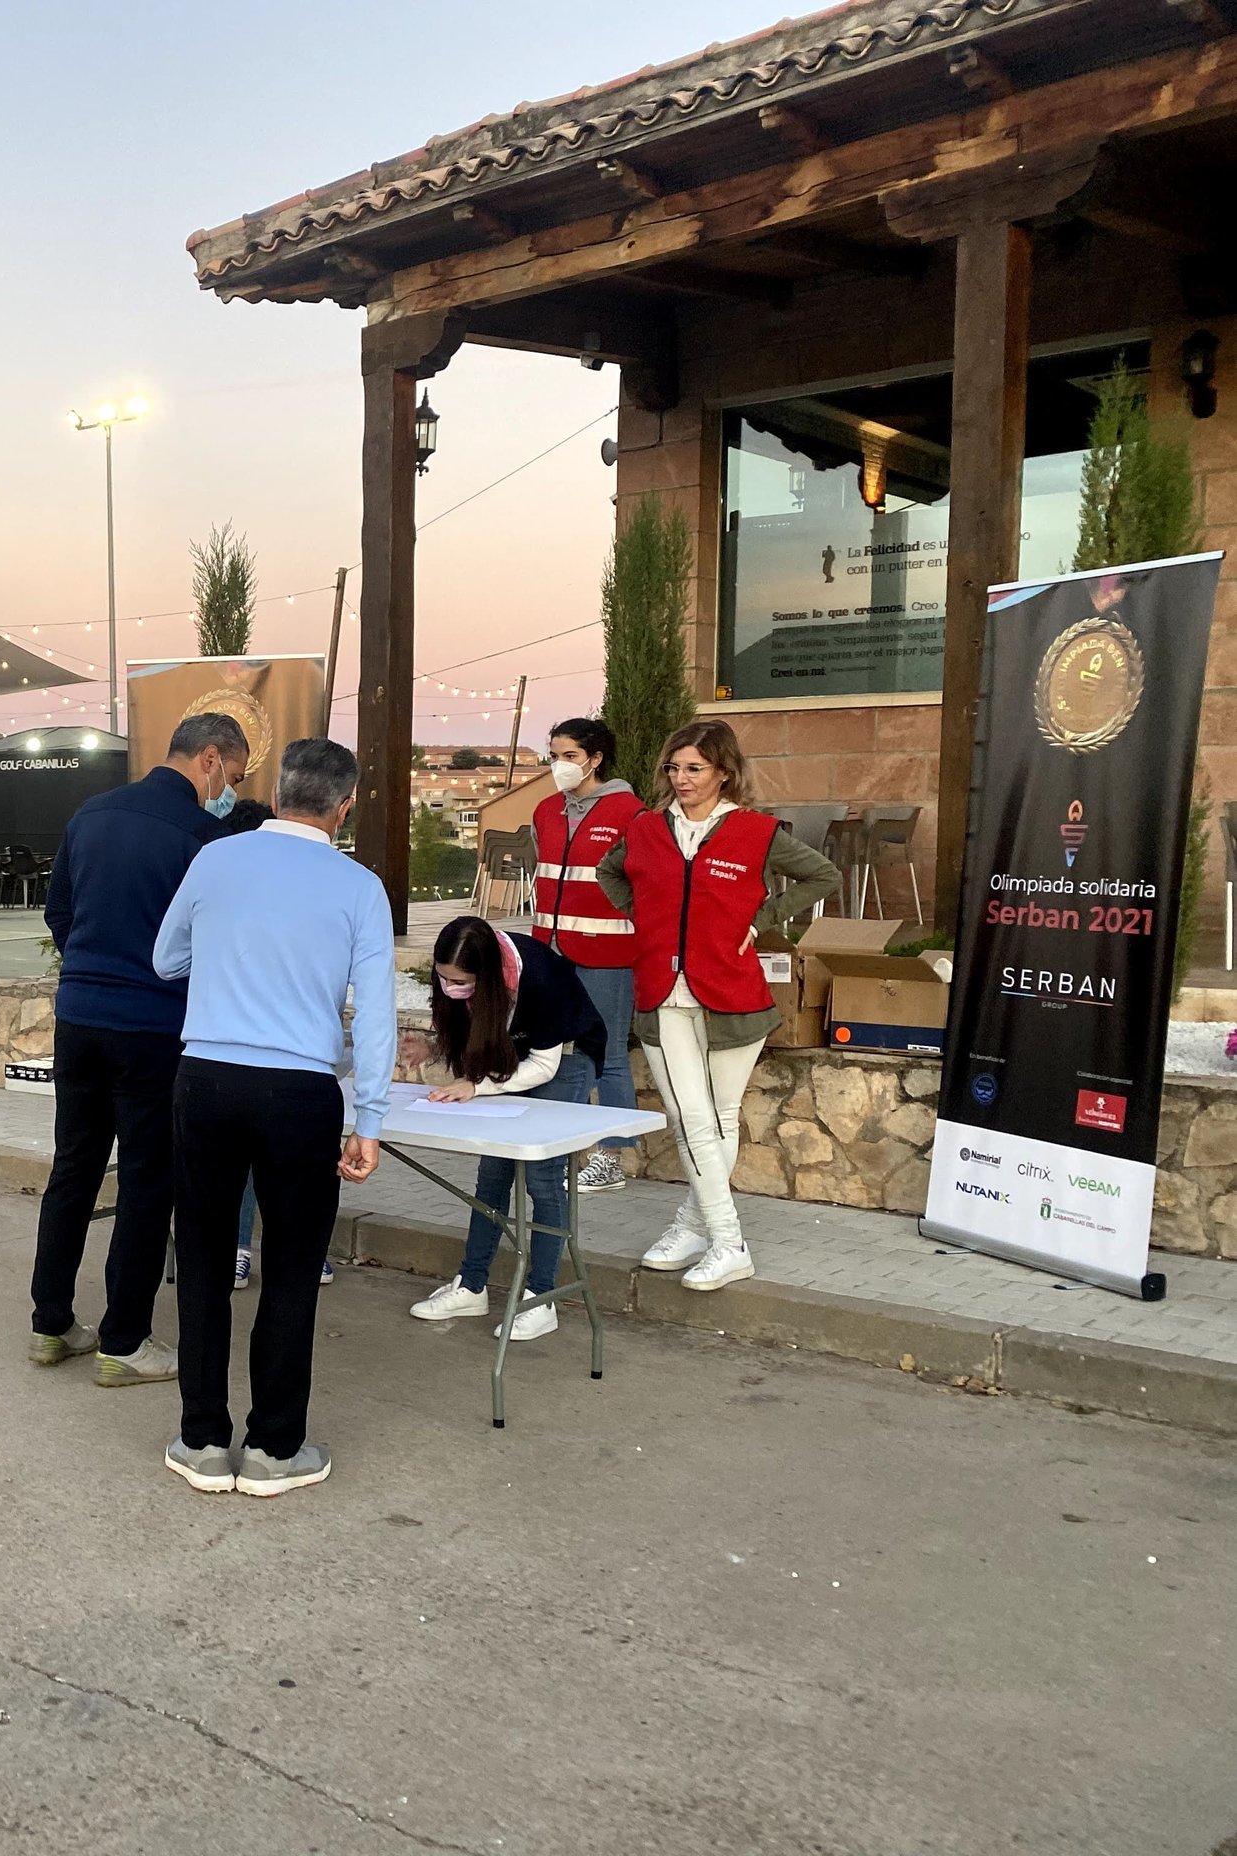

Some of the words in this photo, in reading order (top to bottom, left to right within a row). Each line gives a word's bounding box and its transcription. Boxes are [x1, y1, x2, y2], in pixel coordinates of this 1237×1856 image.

[848, 548, 861, 558] La
[864, 541, 919, 556] Felicidad
[923, 541, 936, 550] es
[847, 565, 868, 575] con
[872, 562, 886, 573] un
[889, 560, 924, 573] putter
[927, 557, 942, 568] en
[772, 612, 808, 621] Somos
[812, 609, 823, 618] lo
[828, 608, 849, 619] que
[854, 604, 906, 615] creemos.
[912, 602, 939, 611] Creo
[0, 760, 22, 771] GOLF
[24, 758, 79, 769] CABANILLAS
[590, 834, 612, 842] España
[712, 859, 748, 872] MAPFRE
[710, 868, 737, 881] España
[990, 874, 1074, 895] Olimpiada
[1079, 878, 1156, 898] solidaria
[986, 900, 1080, 930] Serban
[1088, 906, 1153, 936] 2021
[1001, 967, 1116, 999] SERBAN
[1042, 1001, 1068, 1010] GROUP
[971, 1149, 1002, 1165] Namirial
[955, 1181, 1010, 1203] NUTANIX
